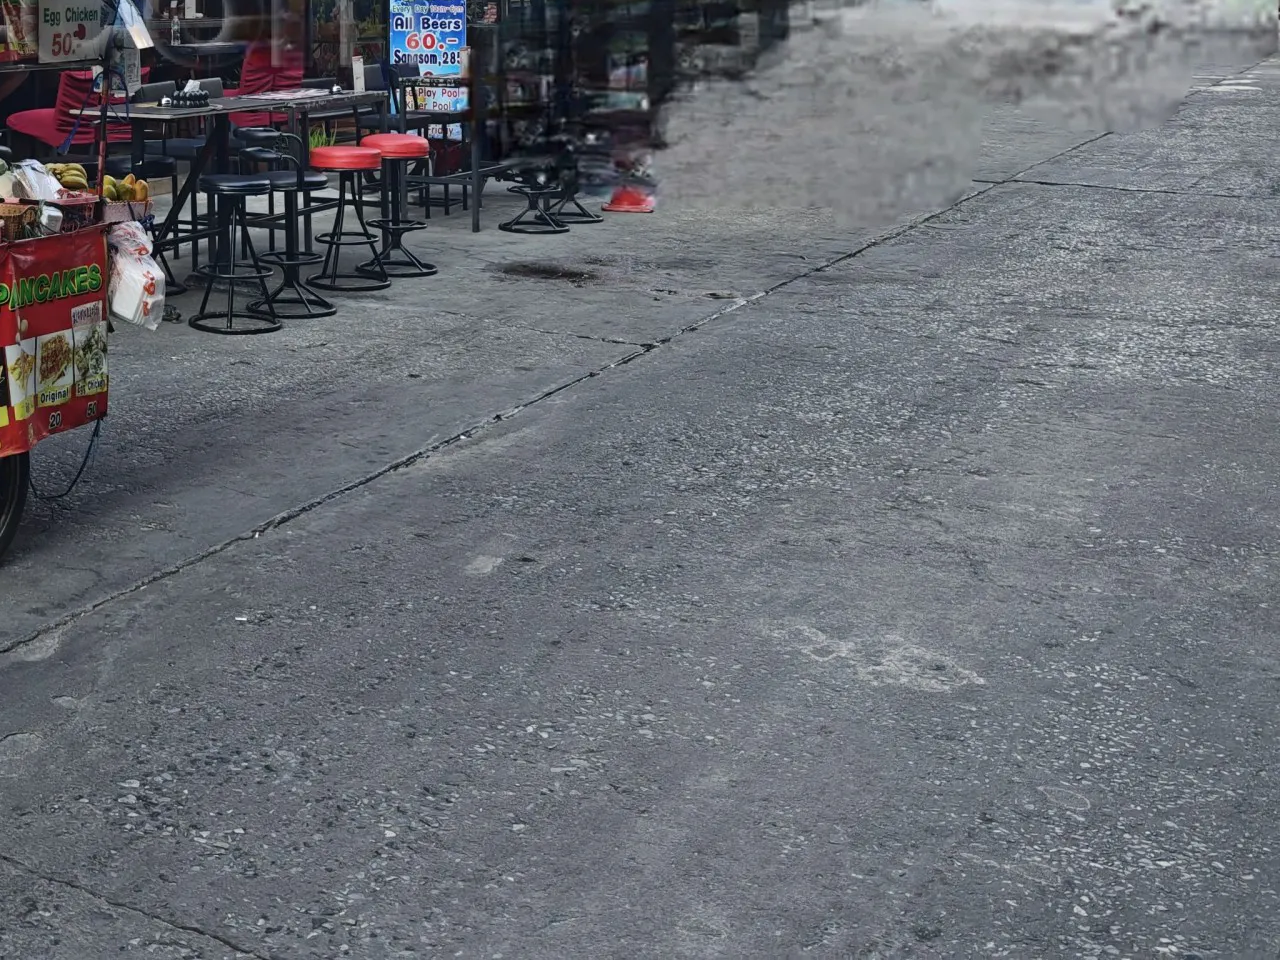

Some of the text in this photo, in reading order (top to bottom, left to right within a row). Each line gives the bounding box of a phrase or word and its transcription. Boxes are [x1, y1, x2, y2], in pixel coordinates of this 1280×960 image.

[44, 8, 61, 26] Egg
[65, 7, 99, 23] Chicken
[392, 5, 412, 14] Every
[415, 5, 429, 14] Day
[394, 16, 462, 31] All Beers
[418, 87, 437, 100] Play
[441, 88, 460, 98] Pool
[432, 101, 451, 111] Pool
[76, 378, 107, 396] Egg Chicken
[39, 389, 70, 404] Original
[86, 401, 98, 418] 50
[48, 411, 62, 429] 20
